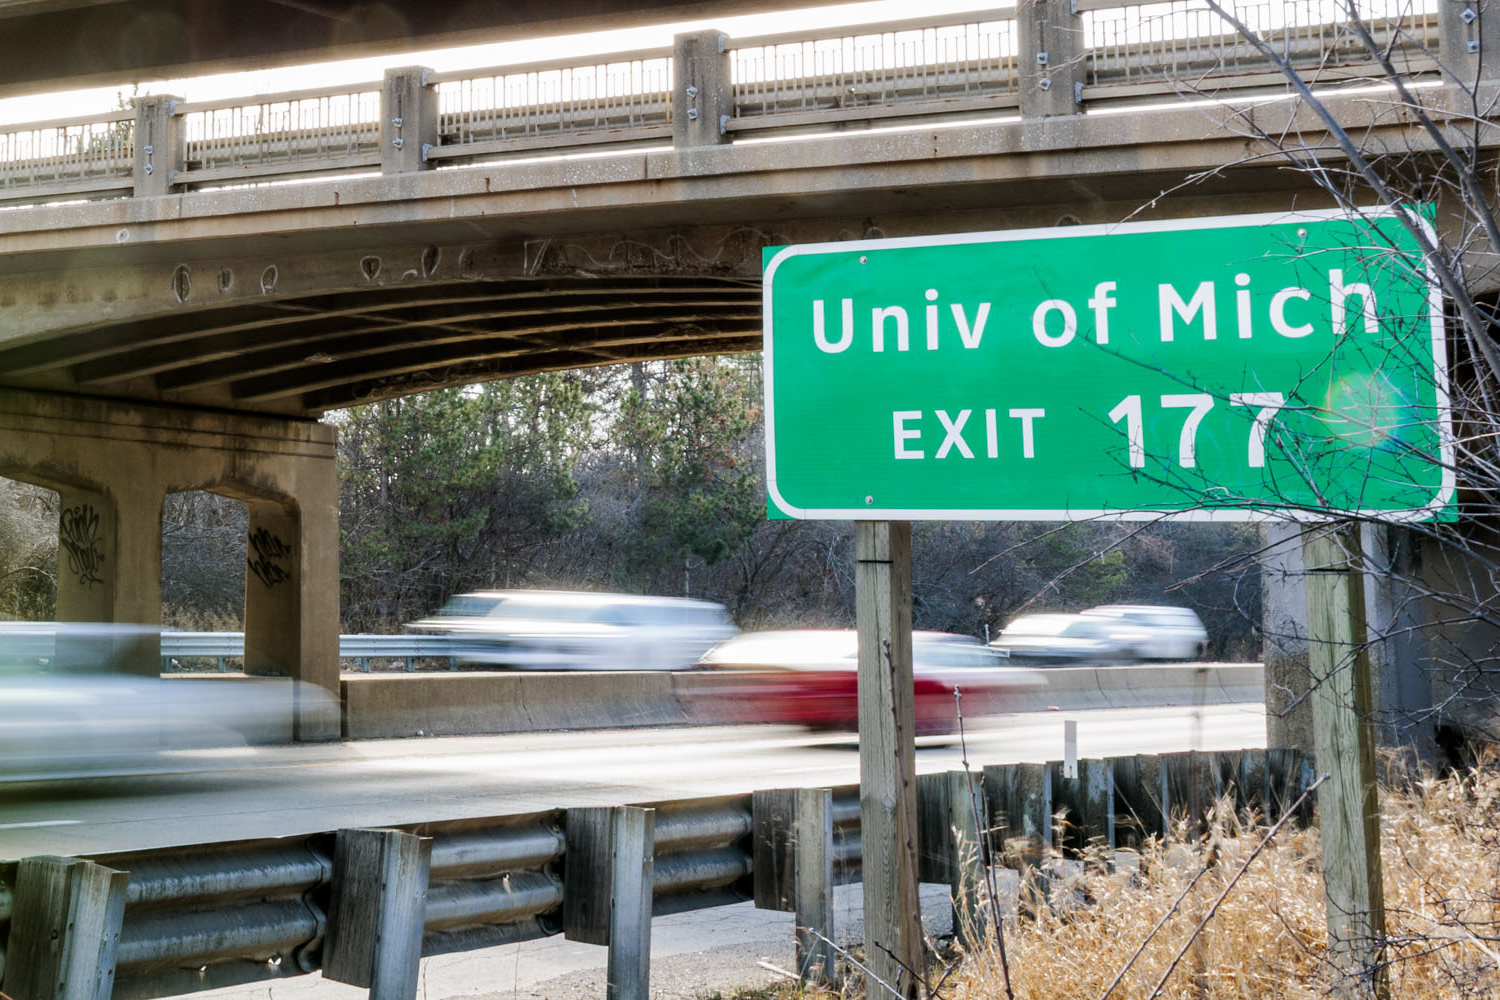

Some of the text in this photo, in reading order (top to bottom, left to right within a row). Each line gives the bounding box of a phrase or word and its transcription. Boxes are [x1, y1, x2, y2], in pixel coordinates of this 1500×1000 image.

[812, 268, 1380, 354] Univ of Mich
[892, 392, 1286, 469] EXIT 177
